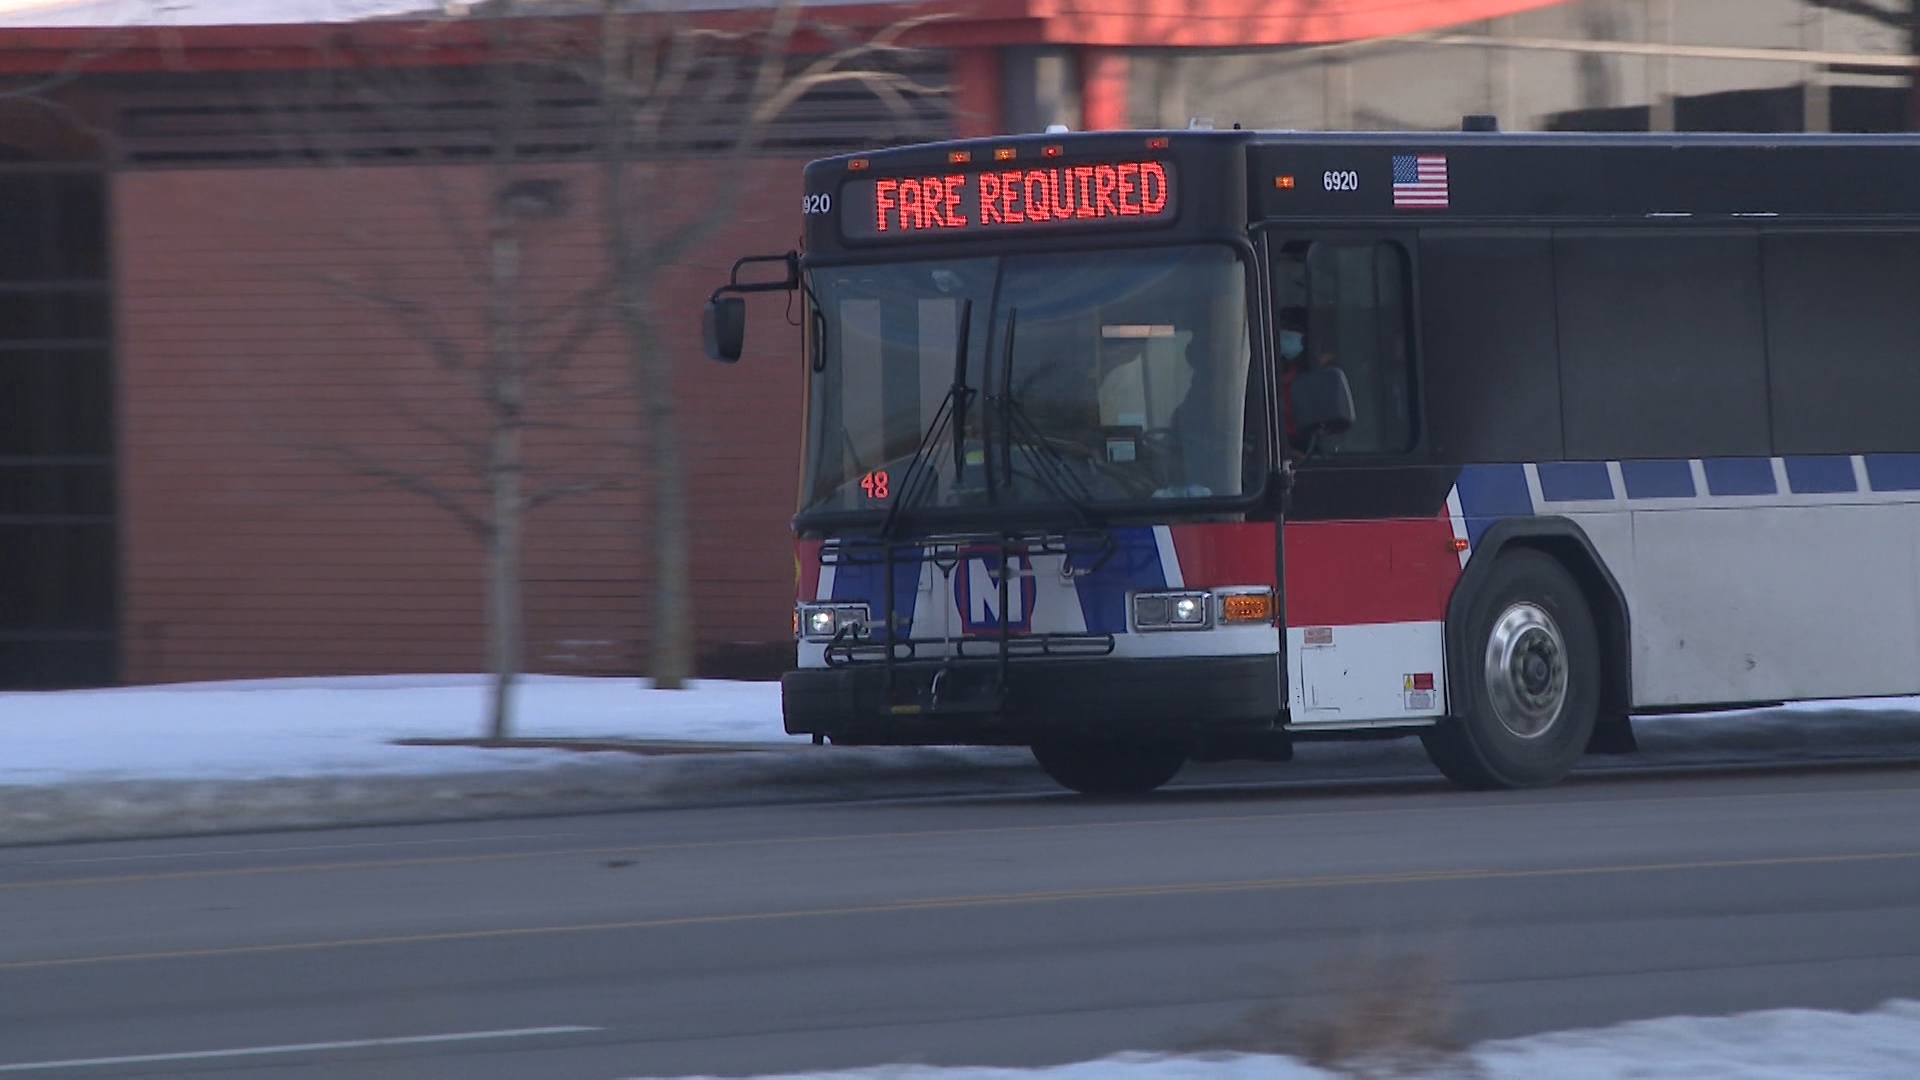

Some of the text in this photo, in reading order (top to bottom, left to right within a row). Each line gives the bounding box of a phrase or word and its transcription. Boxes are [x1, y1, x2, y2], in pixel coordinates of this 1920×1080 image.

[1323, 170, 1358, 191] 6920
[802, 193, 831, 214] 920
[876, 161, 1168, 231] FARE REQUIRED
[860, 470, 889, 499] 48
